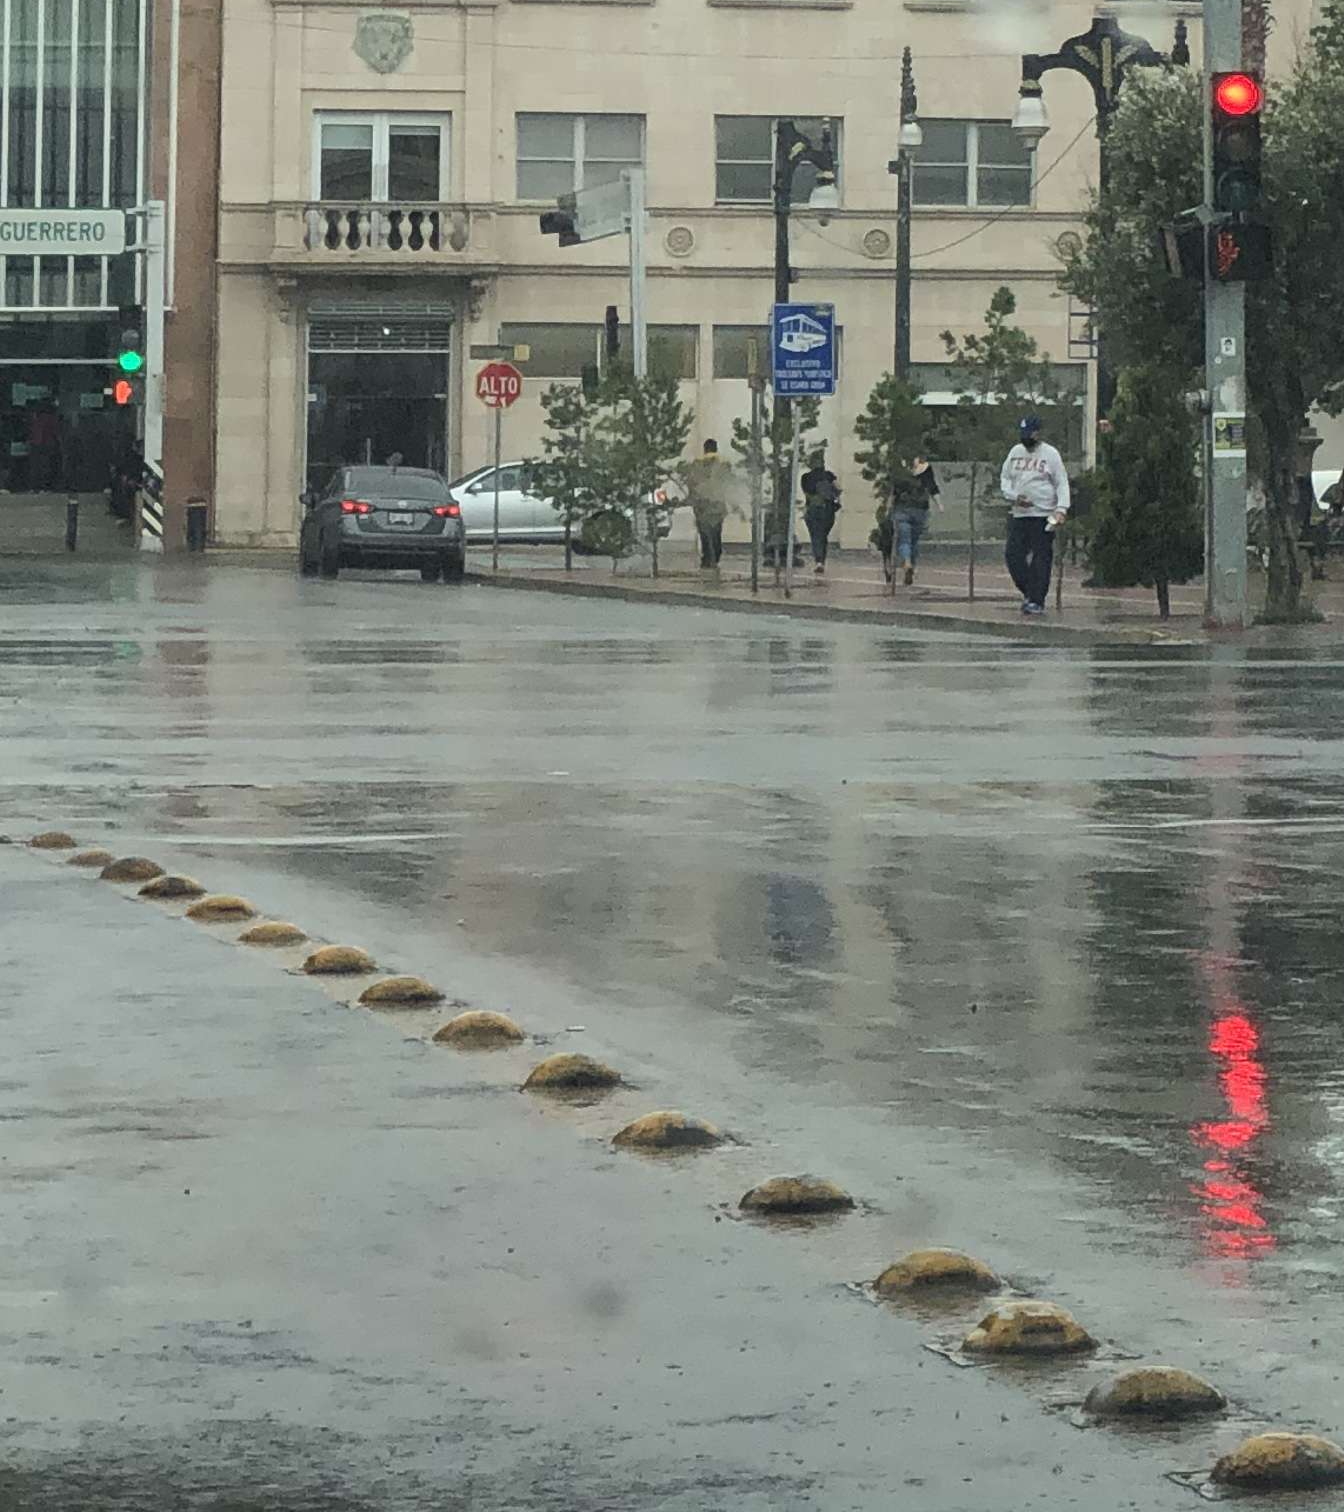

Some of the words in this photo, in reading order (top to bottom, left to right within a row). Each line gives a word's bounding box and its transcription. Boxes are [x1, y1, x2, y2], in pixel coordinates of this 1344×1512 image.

[0, 221, 105, 241] GUERRERO
[479, 376, 518, 395] ALTO
[1010, 457, 1047, 473] TEXAS
